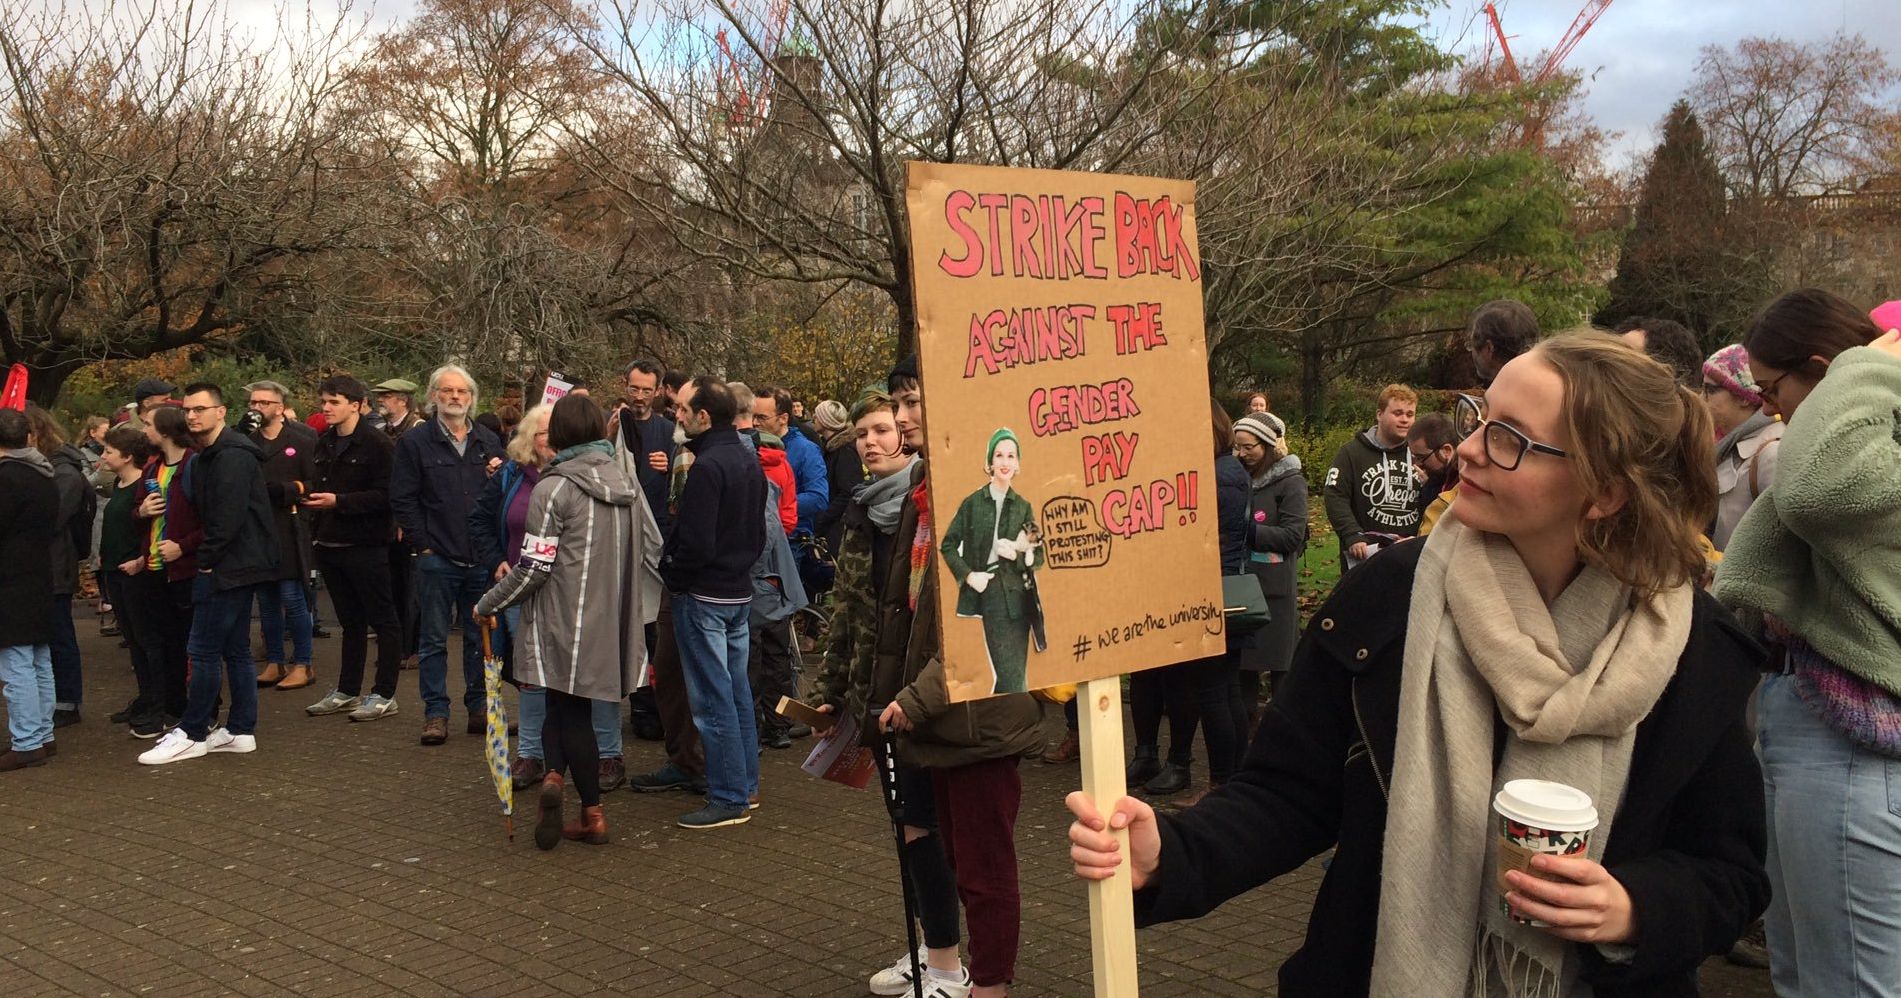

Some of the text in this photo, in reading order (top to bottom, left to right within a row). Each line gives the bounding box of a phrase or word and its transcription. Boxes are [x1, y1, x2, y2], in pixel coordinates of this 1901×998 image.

[938, 189, 1200, 282] STRIKE BACK
[963, 302, 1168, 379] AGAINST THE
[1028, 377, 1141, 437] GENDER
[1081, 430, 1139, 487] PAY
[1361, 460, 1398, 482] TRAK
[1101, 470, 1198, 539] GAP!!
[1361, 476, 1420, 509] Orego
[1044, 501, 1089, 521] WHY AM
[1046, 518, 1088, 536] I STILL
[1048, 530, 1111, 551] PROTESTING
[1050, 544, 1103, 564] THIS SHIT?
